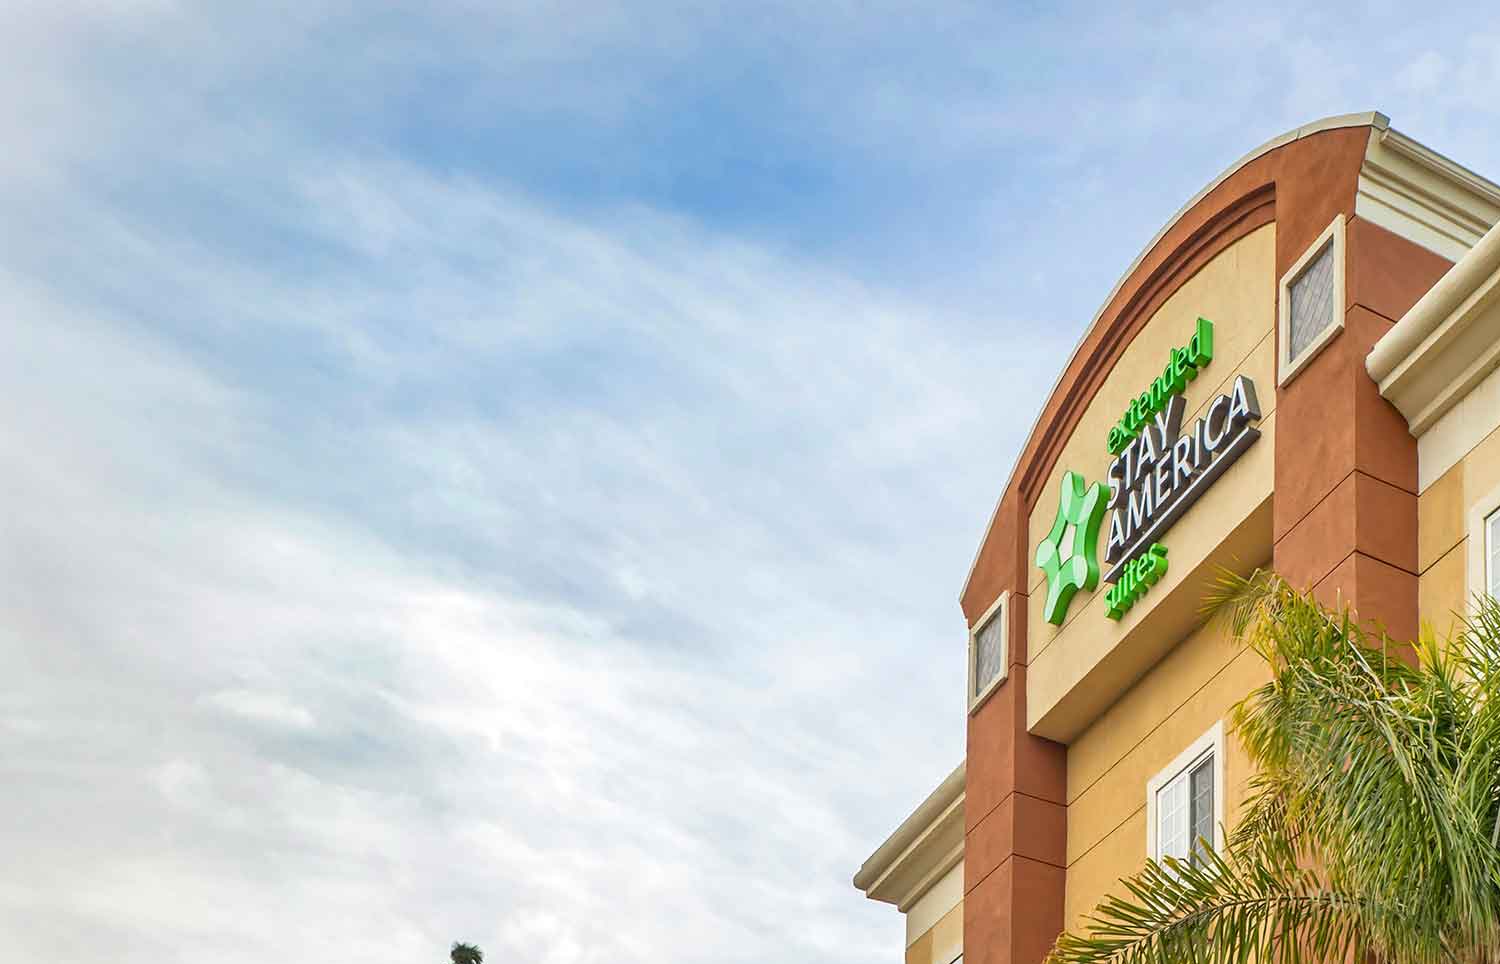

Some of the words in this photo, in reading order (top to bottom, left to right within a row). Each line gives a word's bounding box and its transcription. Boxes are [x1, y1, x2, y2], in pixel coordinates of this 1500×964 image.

[1107, 317, 1212, 456] extended
[1105, 374, 1257, 562] AMERICA
[1106, 395, 1181, 509] STAY
[1104, 543, 1167, 620] suites
